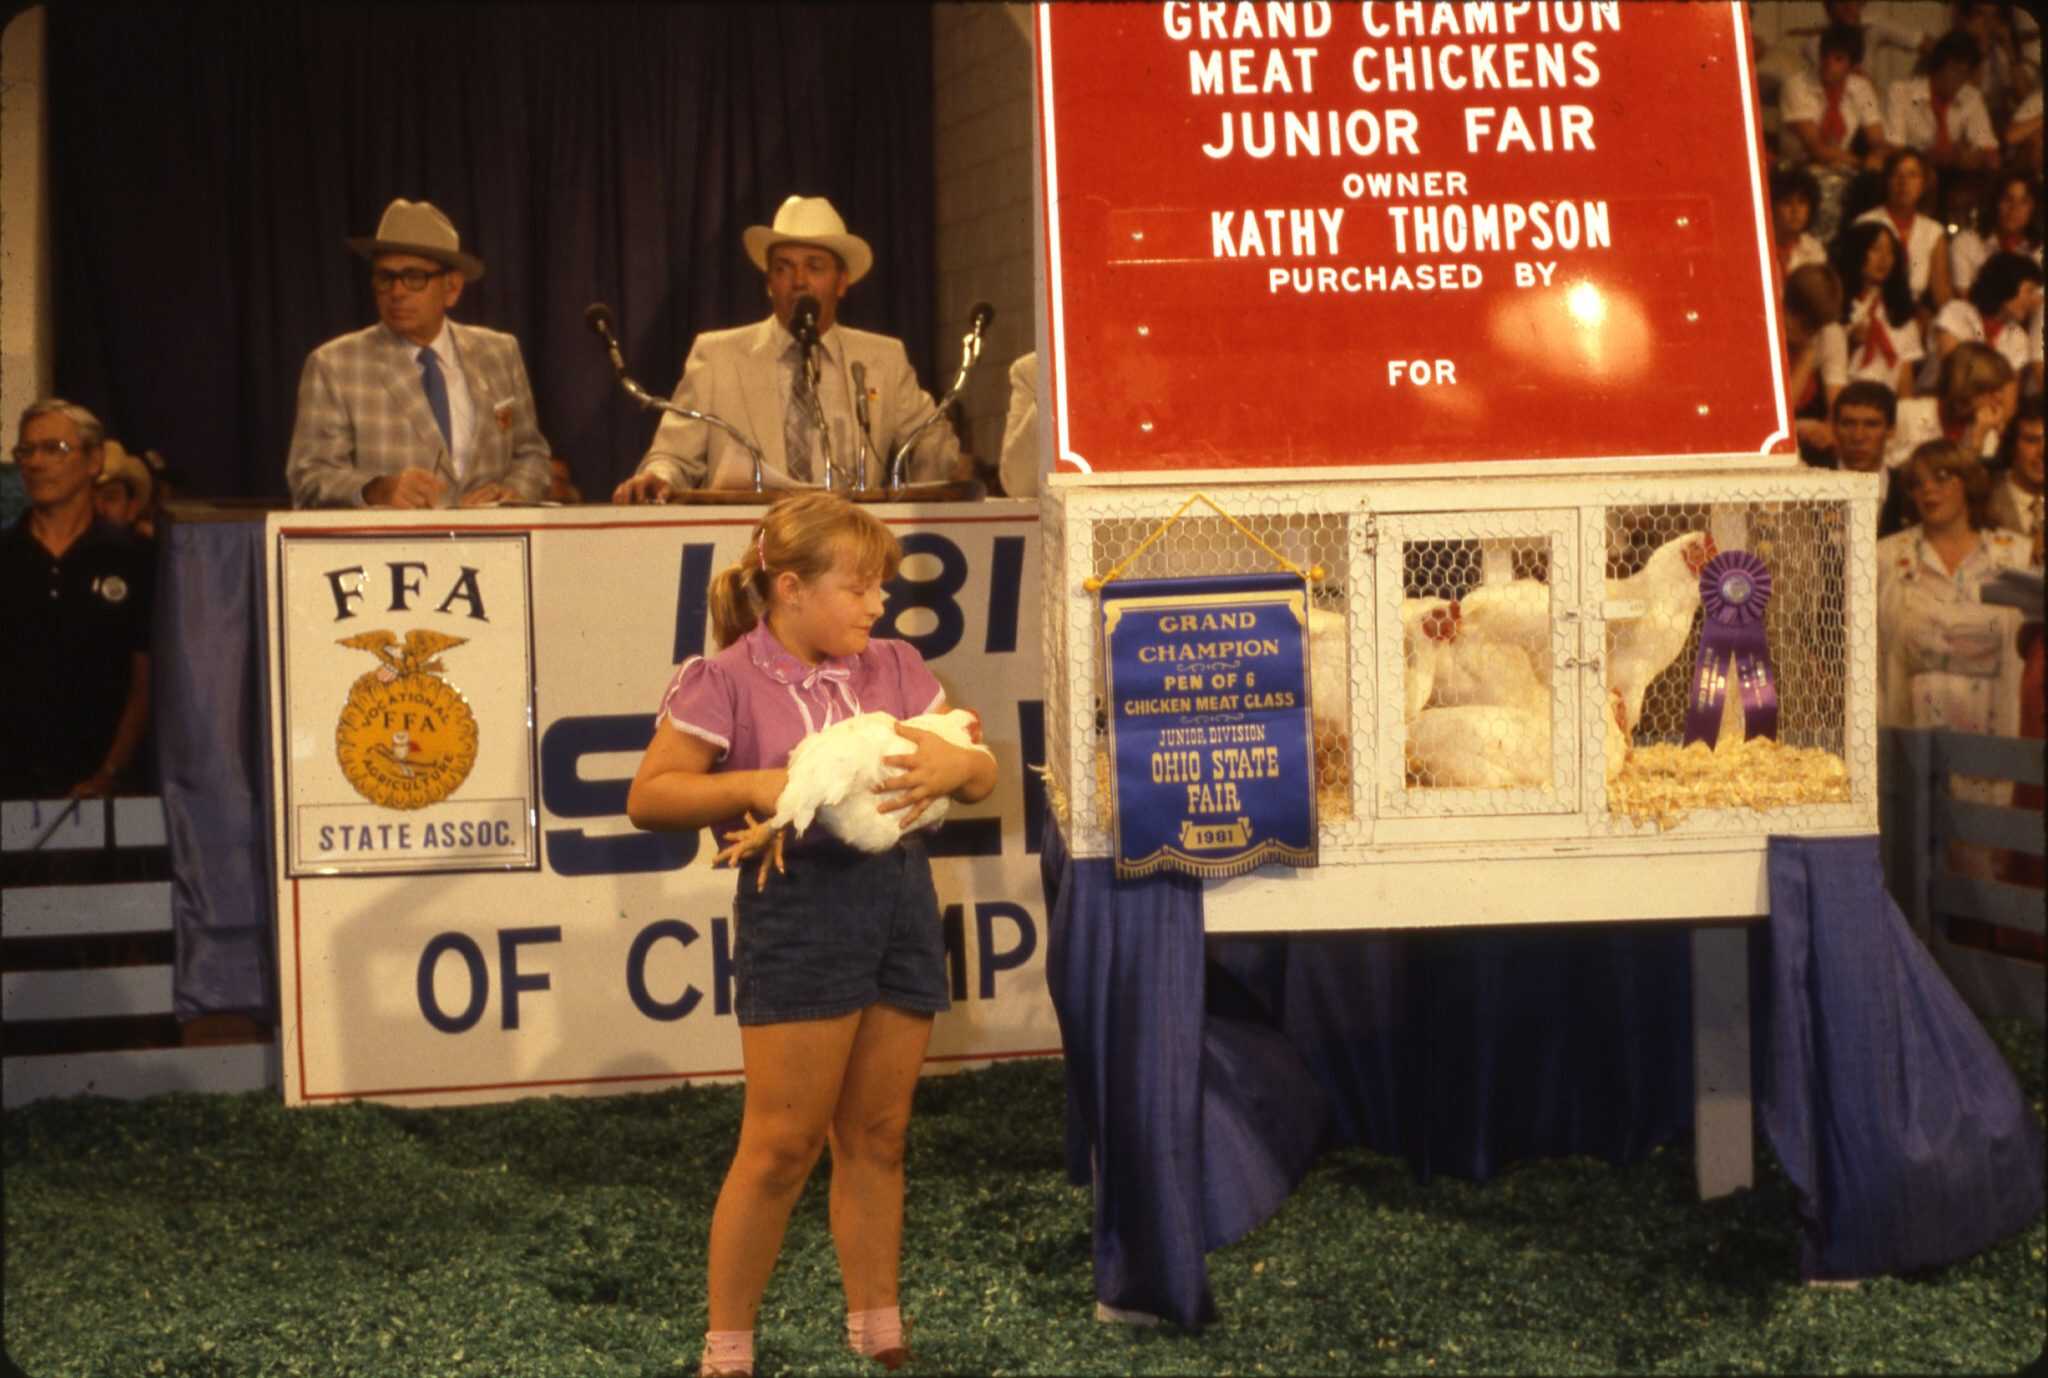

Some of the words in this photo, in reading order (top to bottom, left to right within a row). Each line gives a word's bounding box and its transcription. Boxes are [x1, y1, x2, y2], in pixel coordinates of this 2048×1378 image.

[1163, 1, 1333, 41] GRAND
[1362, 1, 1621, 38] CHAMPION
[1188, 47, 1319, 96] MEAT
[1352, 41, 1601, 93] CHICKENS
[1202, 109, 1420, 160] JUNIOR
[1464, 105, 1596, 154] FAIR
[1342, 171, 1468, 199] OWNER
[1210, 207, 1345, 258] KATHY
[1388, 200, 1611, 254] THOMPSON
[1268, 263, 1484, 294] PURCHASED
[1514, 261, 1558, 288] BY
[1387, 358, 1457, 387] FOR
[324, 561, 490, 623] FFA
[1158, 611, 1257, 633] GRAND
[1137, 639, 1280, 663] CHAMPION
[1164, 673, 1204, 691] PEN
[1211, 672, 1238, 690] OF
[1245, 672, 1256, 688] 6
[1124, 697, 1193, 716] CHICKEN
[1196, 695, 1239, 711] MEAT
[1244, 692, 1295, 709] CLASS
[383, 711, 436, 732] FFA
[1159, 727, 1207, 748] JUNIOR
[1208, 724, 1265, 744] DIVISION
[1151, 750, 1201, 784] OHIO
[1211, 745, 1280, 780] STATE
[1186, 782, 1242, 814] FAIR
[319, 823, 413, 852] STATE
[422, 820, 517, 849] ASSOC.
[1196, 829, 1234, 844] 1981
[417, 926, 562, 1034] OF
